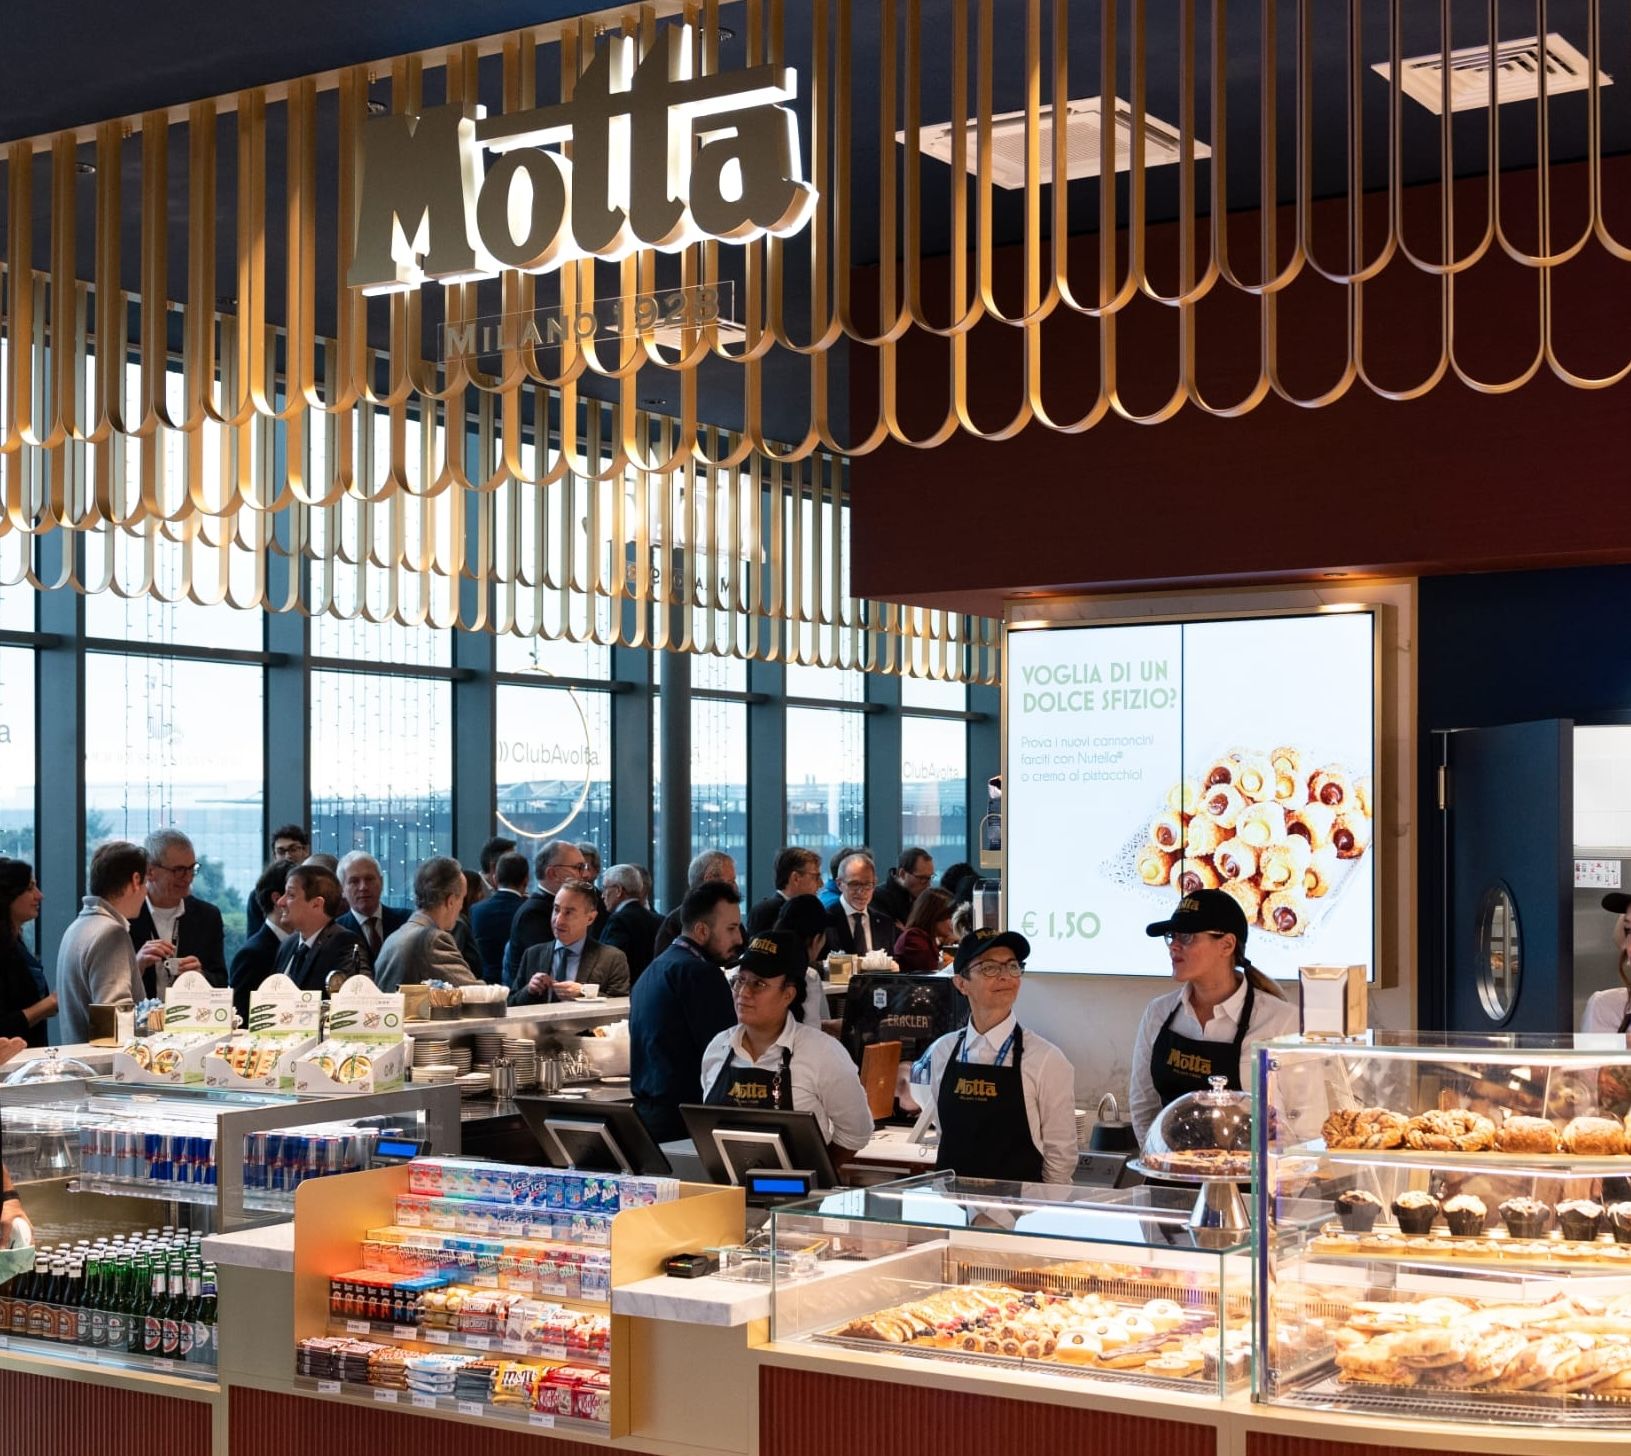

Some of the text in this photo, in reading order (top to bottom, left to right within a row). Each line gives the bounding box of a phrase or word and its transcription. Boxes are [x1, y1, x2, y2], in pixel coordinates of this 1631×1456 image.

[348, 26, 818, 295] Motta
[442, 286, 721, 360] MILANO 1928
[1022, 660, 1168, 686] VOGLIA DI UN
[1023, 688, 1177, 713] DOLCE SFIZIO?
[1021, 736, 1052, 748] Prova
[1061, 737, 1090, 748] nuovi
[1093, 735, 1154, 747] cannoncini
[511, 742, 600, 766] ClubAvolta
[1021, 753, 1050, 765] farciti
[1053, 755, 1075, 764] con
[1032, 771, 1066, 782] crema
[1021, 911, 1101, 940] € 1,50
[887, 1014, 929, 1028] ERACLEA
[1167, 1048, 1212, 1075] Motta
[728, 1081, 768, 1099] Motta
[954, 1077, 998, 1097] Motta
